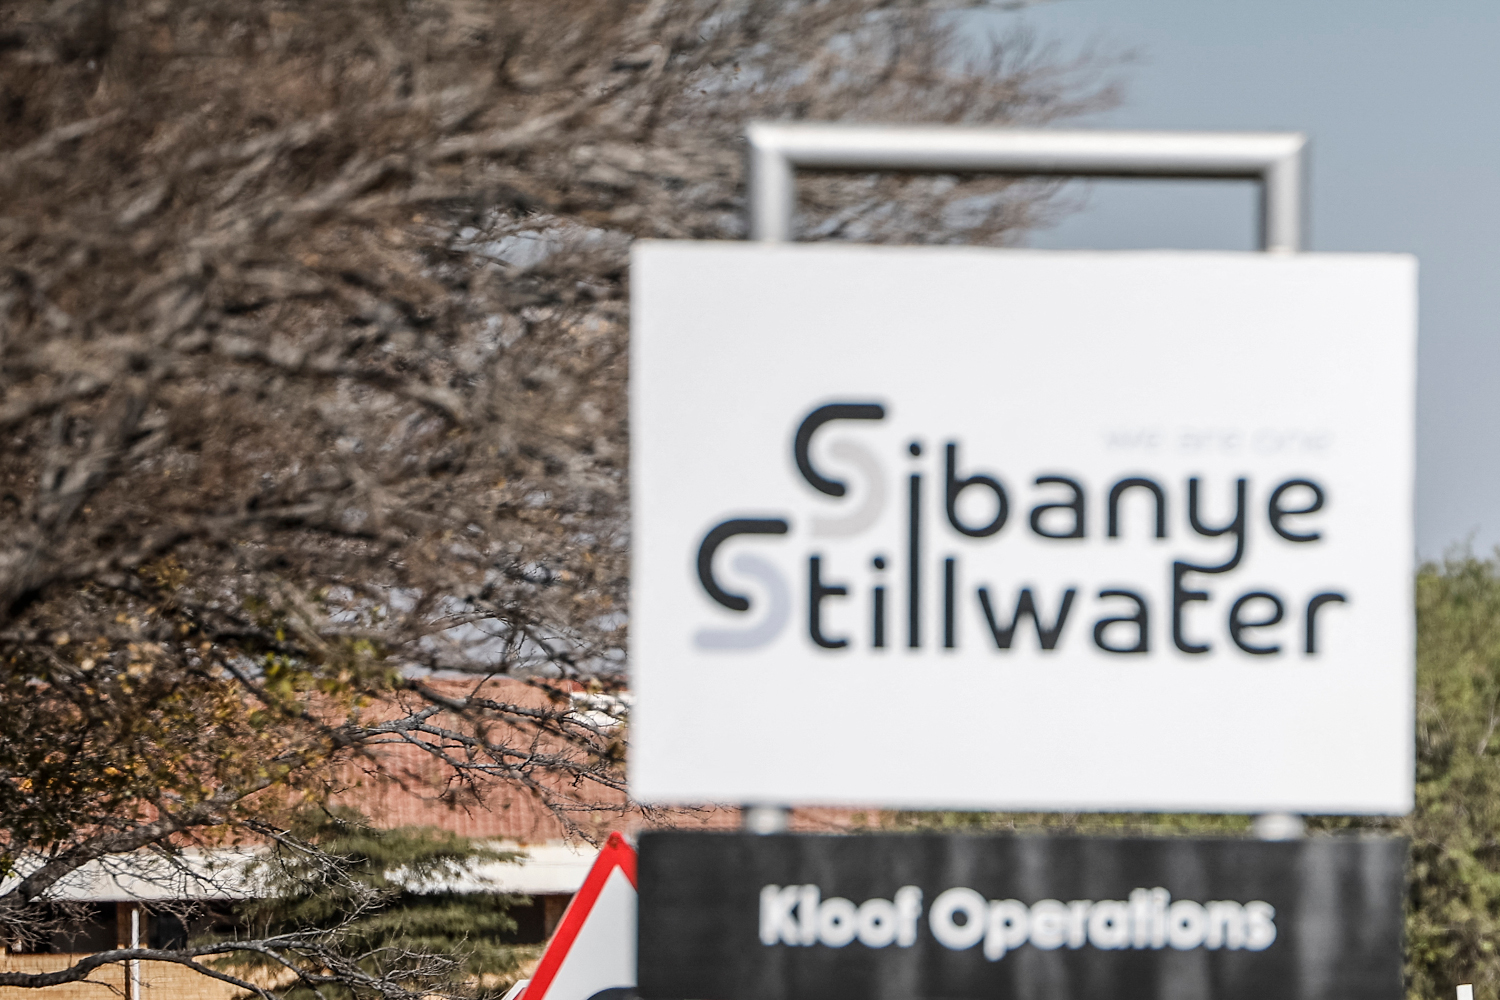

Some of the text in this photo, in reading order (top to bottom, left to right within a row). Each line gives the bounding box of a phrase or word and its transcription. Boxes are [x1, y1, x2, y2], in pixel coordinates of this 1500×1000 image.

[793, 402, 1328, 576] Sibanye
[692, 516, 1350, 656] Stillwater
[759, 884, 1278, 961] Kloof Operations
